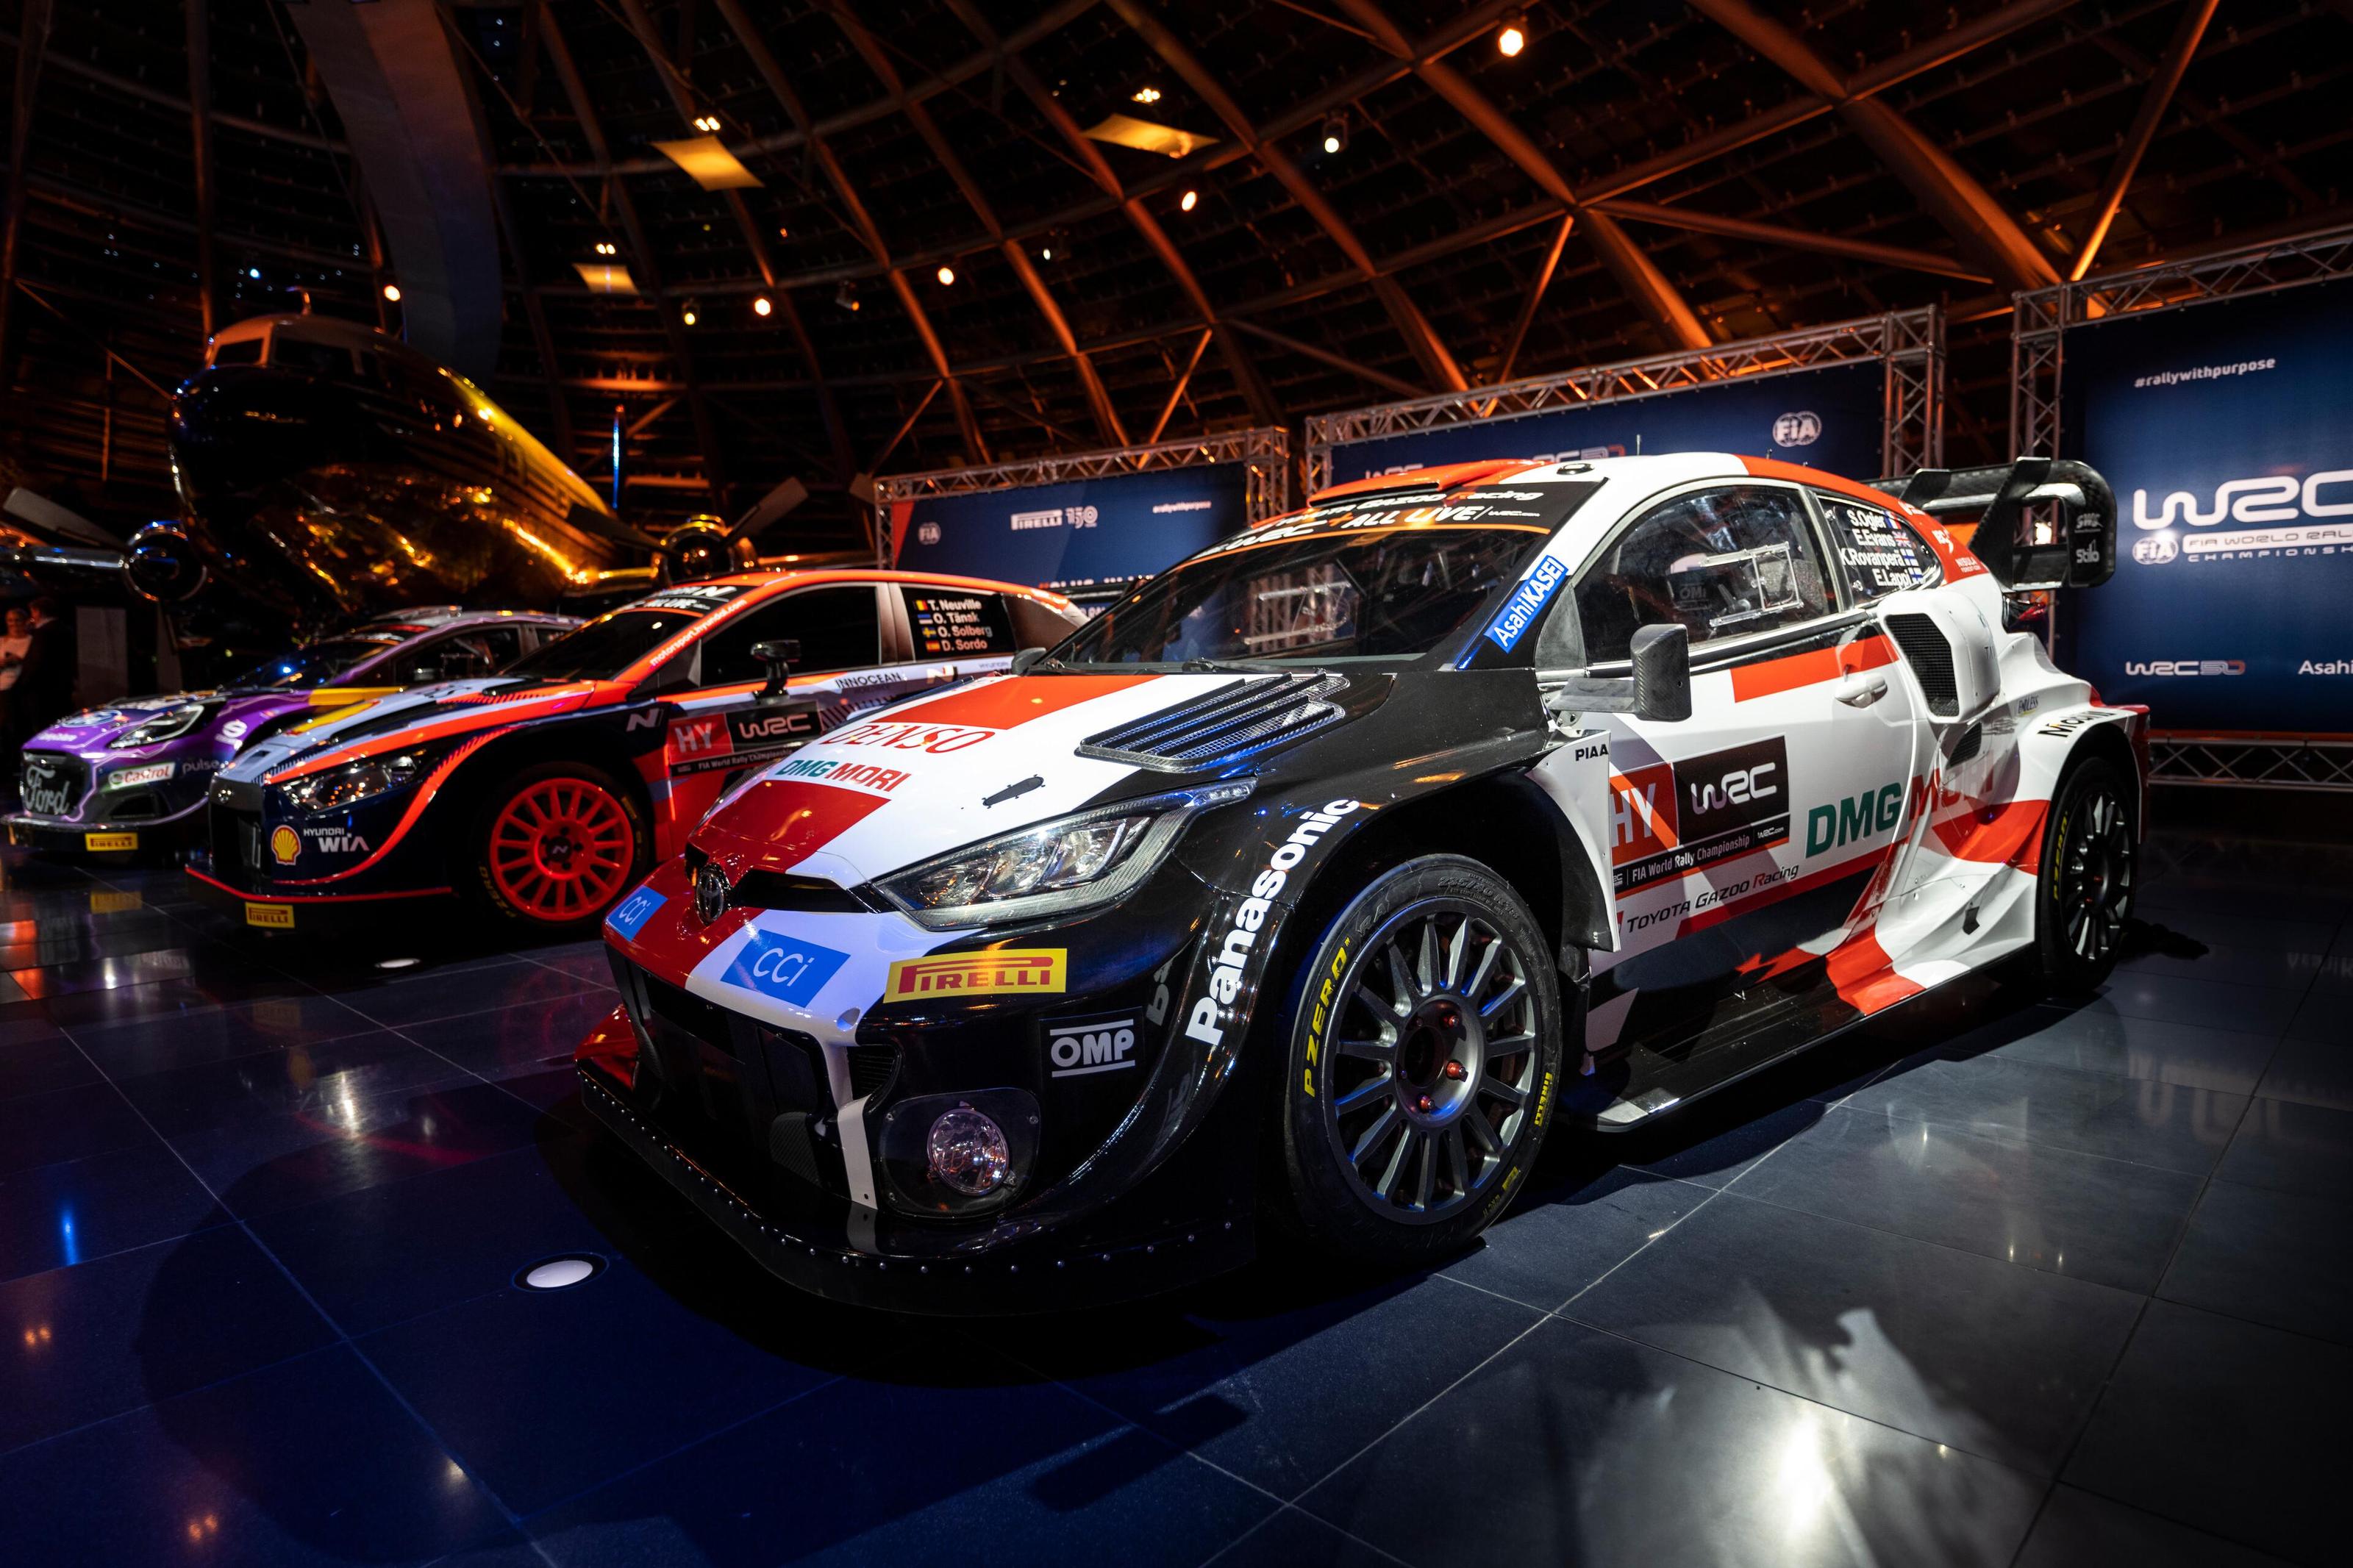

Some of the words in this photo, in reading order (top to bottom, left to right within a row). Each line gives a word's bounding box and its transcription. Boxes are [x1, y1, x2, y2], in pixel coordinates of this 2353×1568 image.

[2134, 358, 2277, 388] #rallywithpurpose
[1774, 415, 1818, 444] FIA
[1357, 494, 1446, 509] GAZOO
[1446, 490, 1543, 501] Racing
[2133, 469, 2353, 529] WRC
[1011, 509, 1063, 530] PIRELLI
[1340, 511, 1401, 529] ALL
[1846, 509, 1888, 531] S.Ogier
[919, 524, 940, 543] FIA
[1852, 528, 1896, 547] E.Evans
[2188, 539, 2218, 554] FIA
[2224, 532, 2299, 554] WORLD
[2135, 538, 2177, 562] FIA
[927, 600, 939, 611] T.
[939, 598, 982, 611] Neuville
[933, 613, 946, 624] O.
[946, 612, 980, 623] Tänak
[938, 626, 951, 637] O.
[951, 626, 993, 637] Solberg
[941, 640, 954, 651] D.
[956, 639, 988, 650] Sordo
[2298, 660, 2353, 675] Asahi
[835, 673, 902, 689] INNOCEAN
[674, 722, 713, 753] HY
[738, 714, 812, 740] WRC
[820, 724, 996, 754] DENSO
[1574, 743, 1610, 762] PIAA
[123, 765, 170, 784] Castrol
[182, 759, 220, 773] pulse
[774, 759, 839, 777] DMG
[824, 762, 912, 792] MORI
[25, 765, 71, 814] Ford
[1690, 762, 1778, 815] WRC
[1804, 782, 1902, 859] DMG
[90, 837, 133, 846] PIRELLI
[303, 828, 345, 837] HYUNDAI
[1632, 866, 1647, 882] FIA
[1648, 859, 1673, 877] World
[1674, 852, 1696, 868] Rally
[1696, 835, 1750, 861] Championship
[1627, 901, 1691, 934] TOYOTA
[1695, 881, 1750, 909] GAZOO
[1752, 864, 1799, 889] Racing
[249, 906, 288, 923] PIRELLI
[1185, 799, 1360, 1046] Panasonic
[898, 956, 1054, 994] PIRELLI
[1050, 1028, 1135, 1067] OMP
